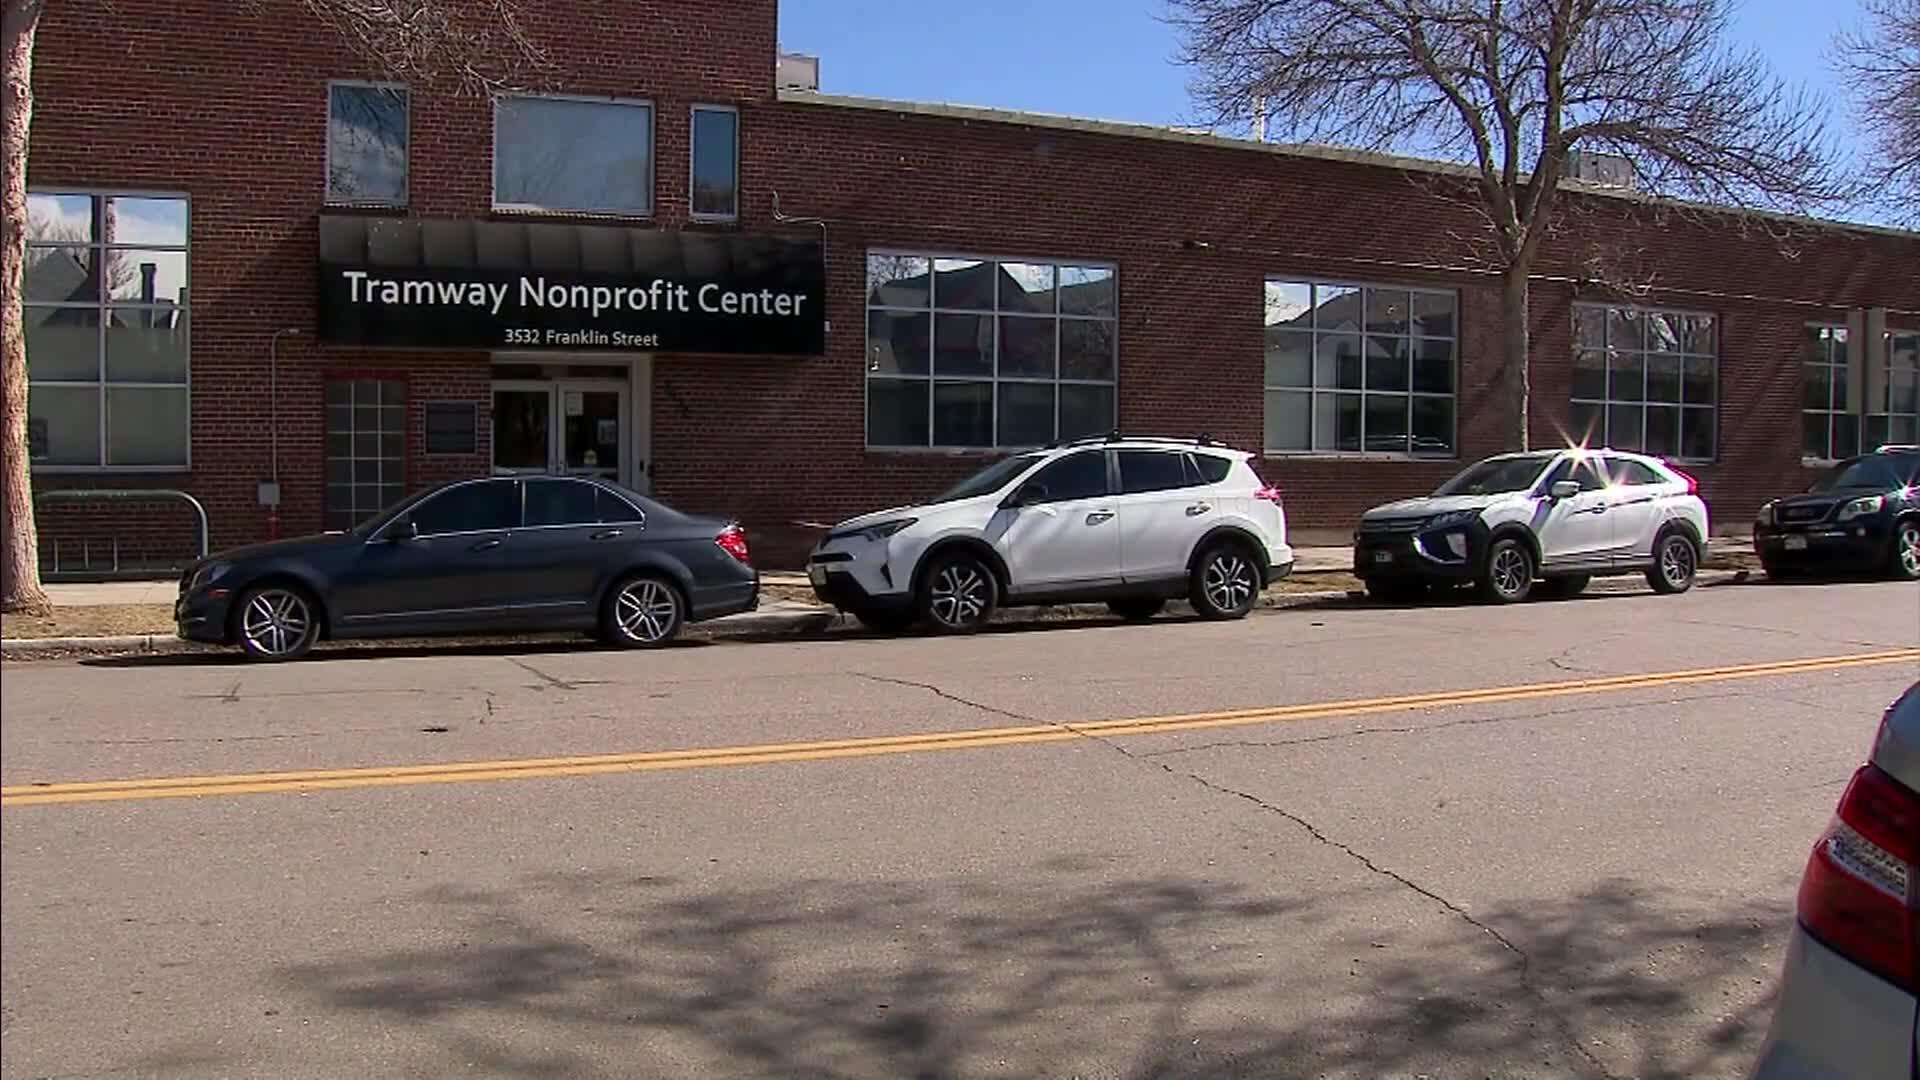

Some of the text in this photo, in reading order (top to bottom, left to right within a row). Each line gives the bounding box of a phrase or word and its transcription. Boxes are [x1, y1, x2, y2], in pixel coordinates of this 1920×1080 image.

[342, 271, 807, 318] Tramway Nonprofit Center
[504, 328, 659, 347] 3532 Franklin Street
